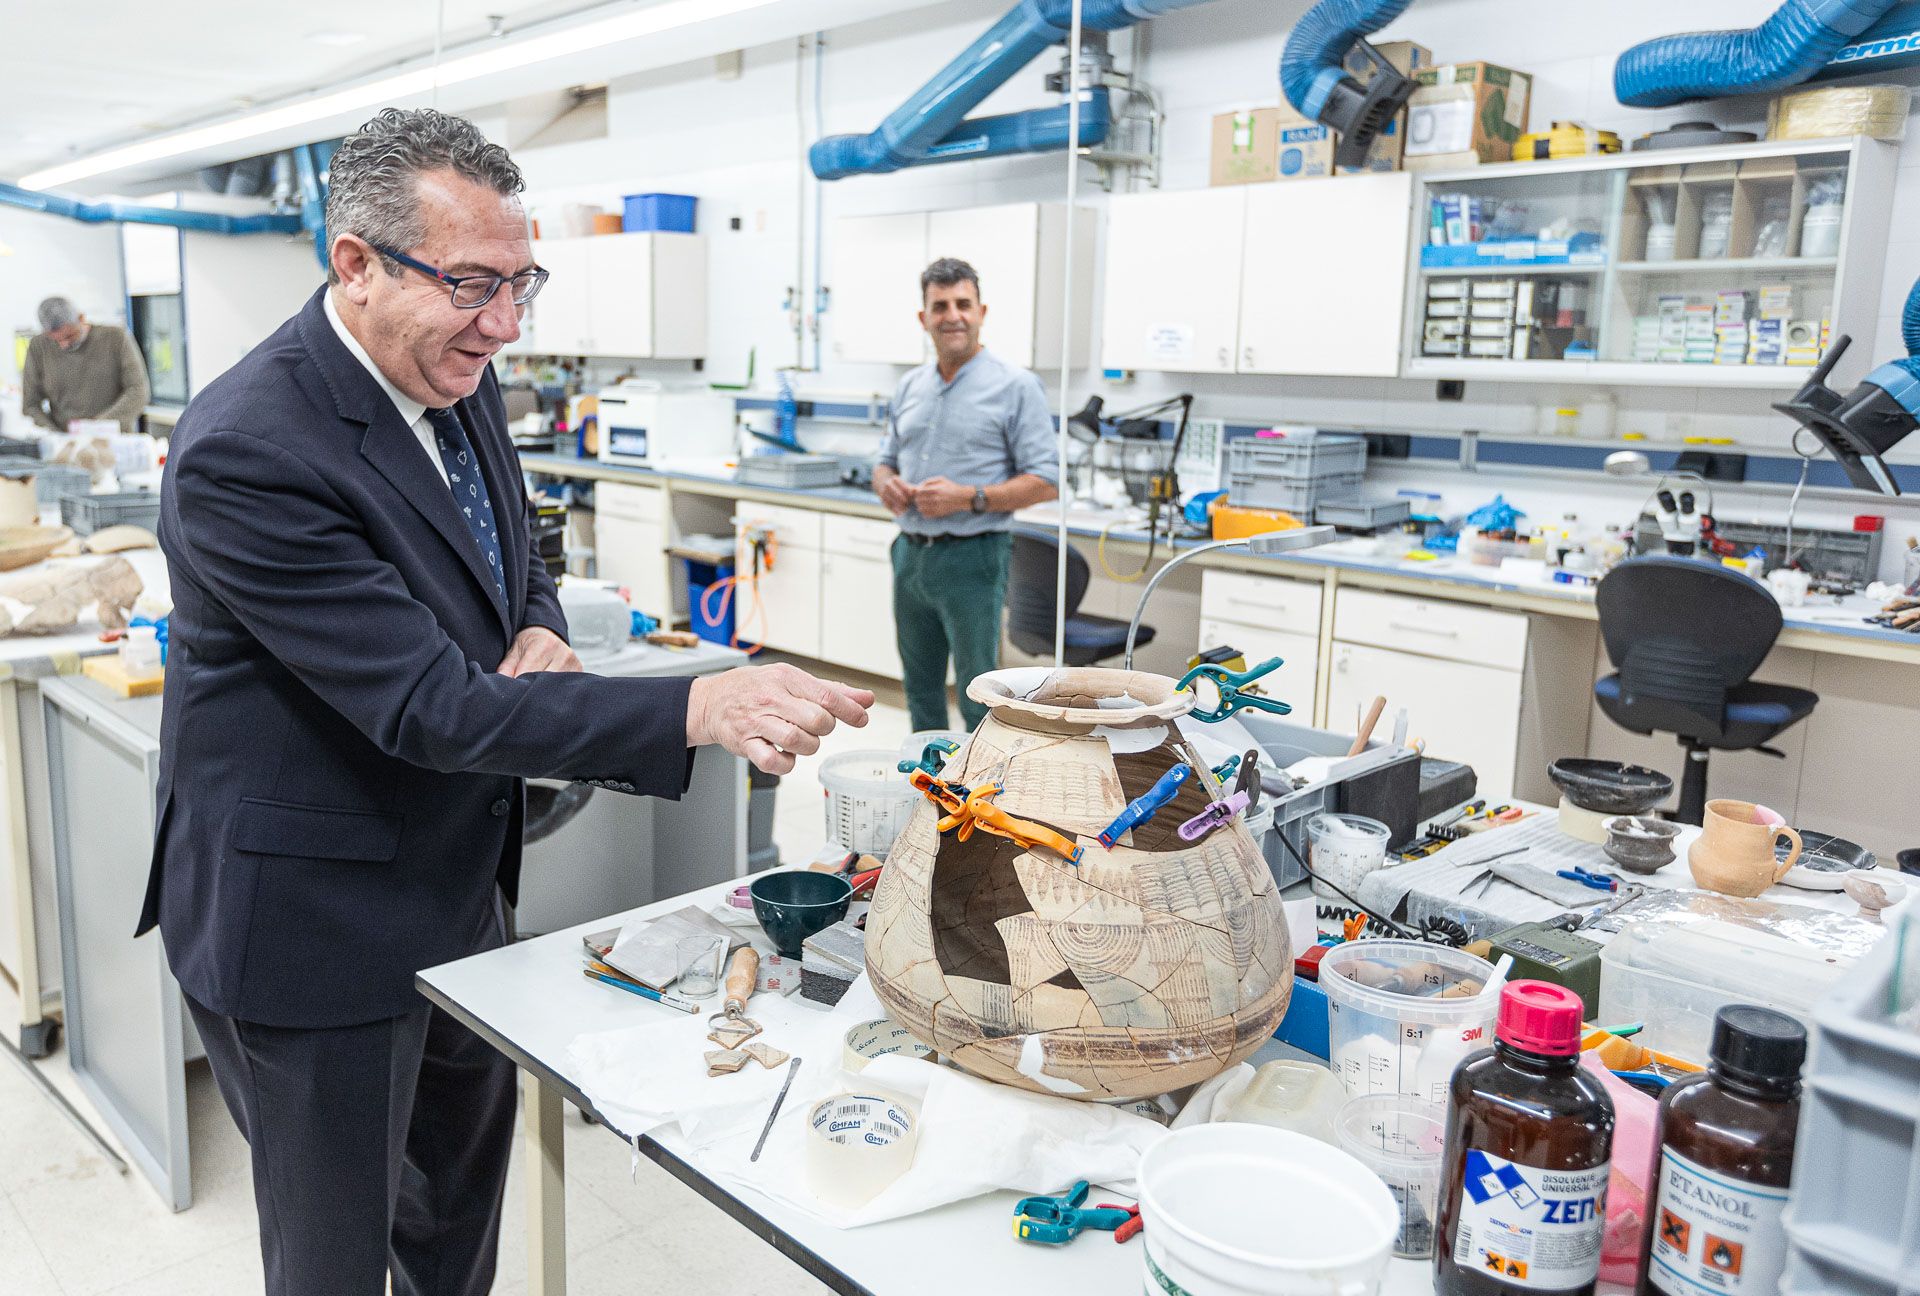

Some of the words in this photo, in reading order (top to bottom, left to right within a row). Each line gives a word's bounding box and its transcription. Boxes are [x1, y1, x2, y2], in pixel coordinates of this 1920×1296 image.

[1406, 1029, 1423, 1039] 5:1
[1461, 1027, 1483, 1042] 3M
[829, 1120, 861, 1132] COMFAM
[1541, 1183, 1590, 1193] UNIVERSAL
[1669, 1169, 1755, 1219] ETANOL
